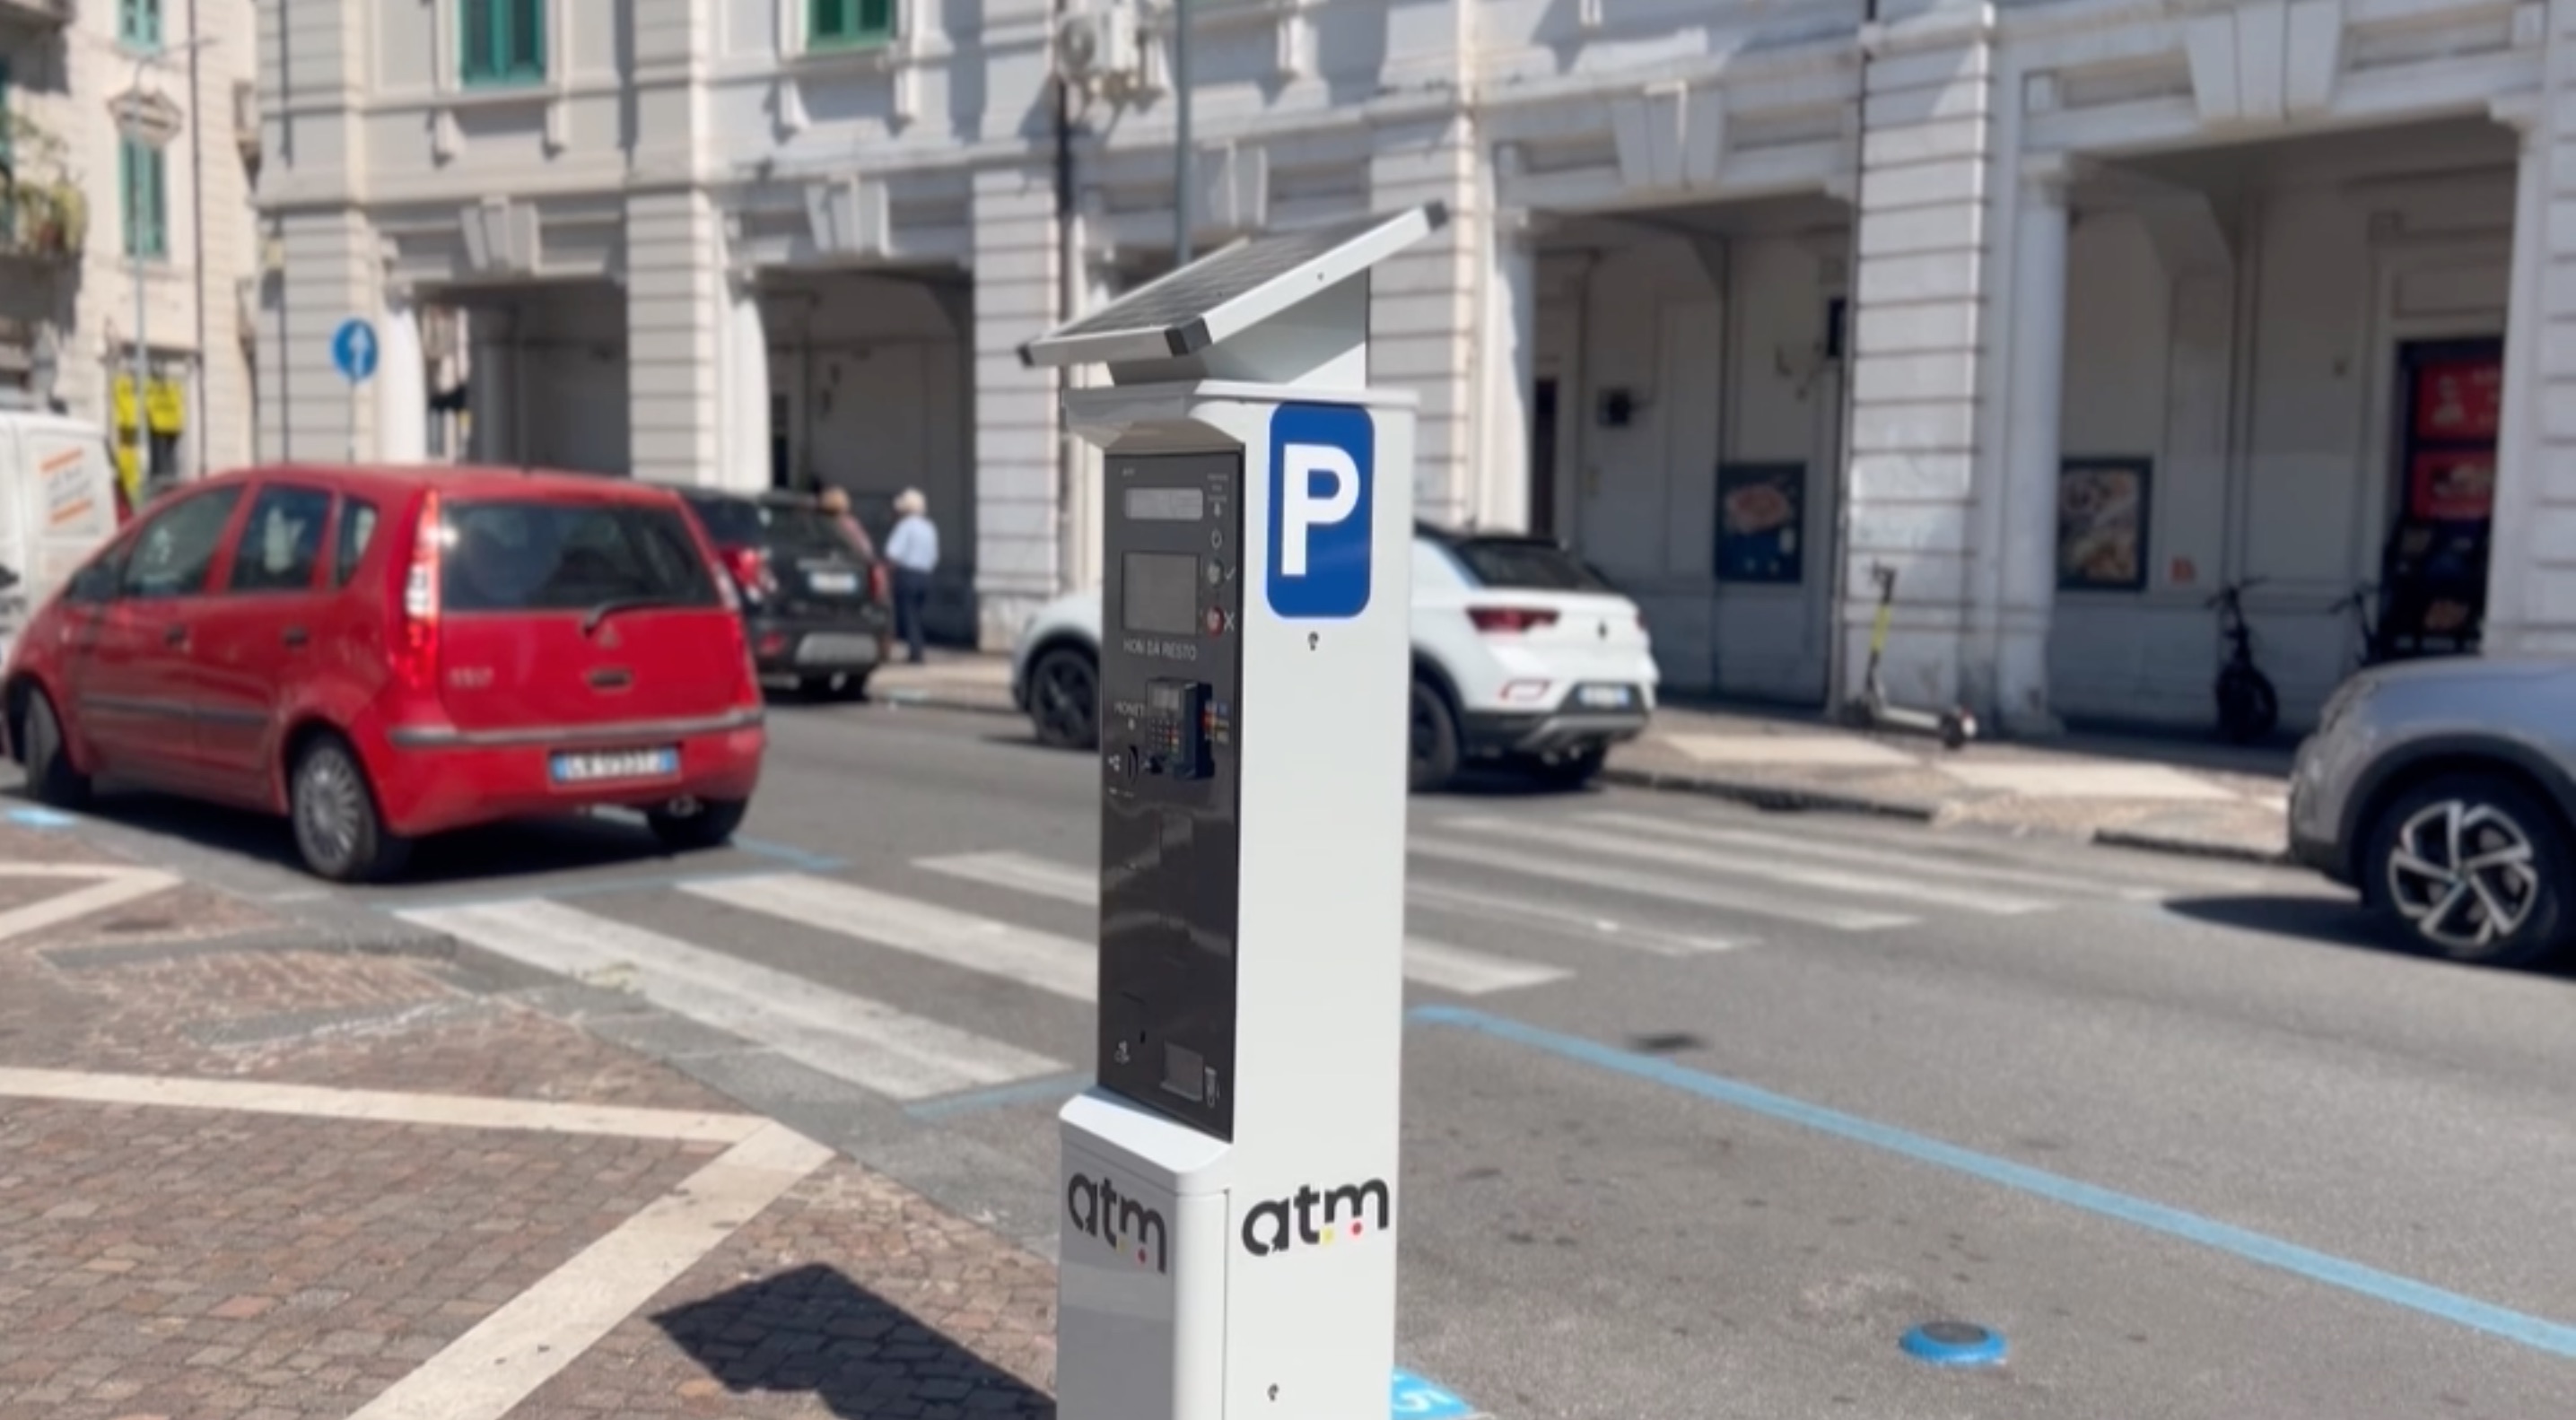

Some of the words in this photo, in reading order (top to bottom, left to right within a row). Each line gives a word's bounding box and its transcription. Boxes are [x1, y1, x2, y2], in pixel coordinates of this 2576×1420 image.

[1281, 443, 1360, 576] P
[1067, 1172, 1166, 1274] atm
[1242, 1178, 1390, 1257] atm
